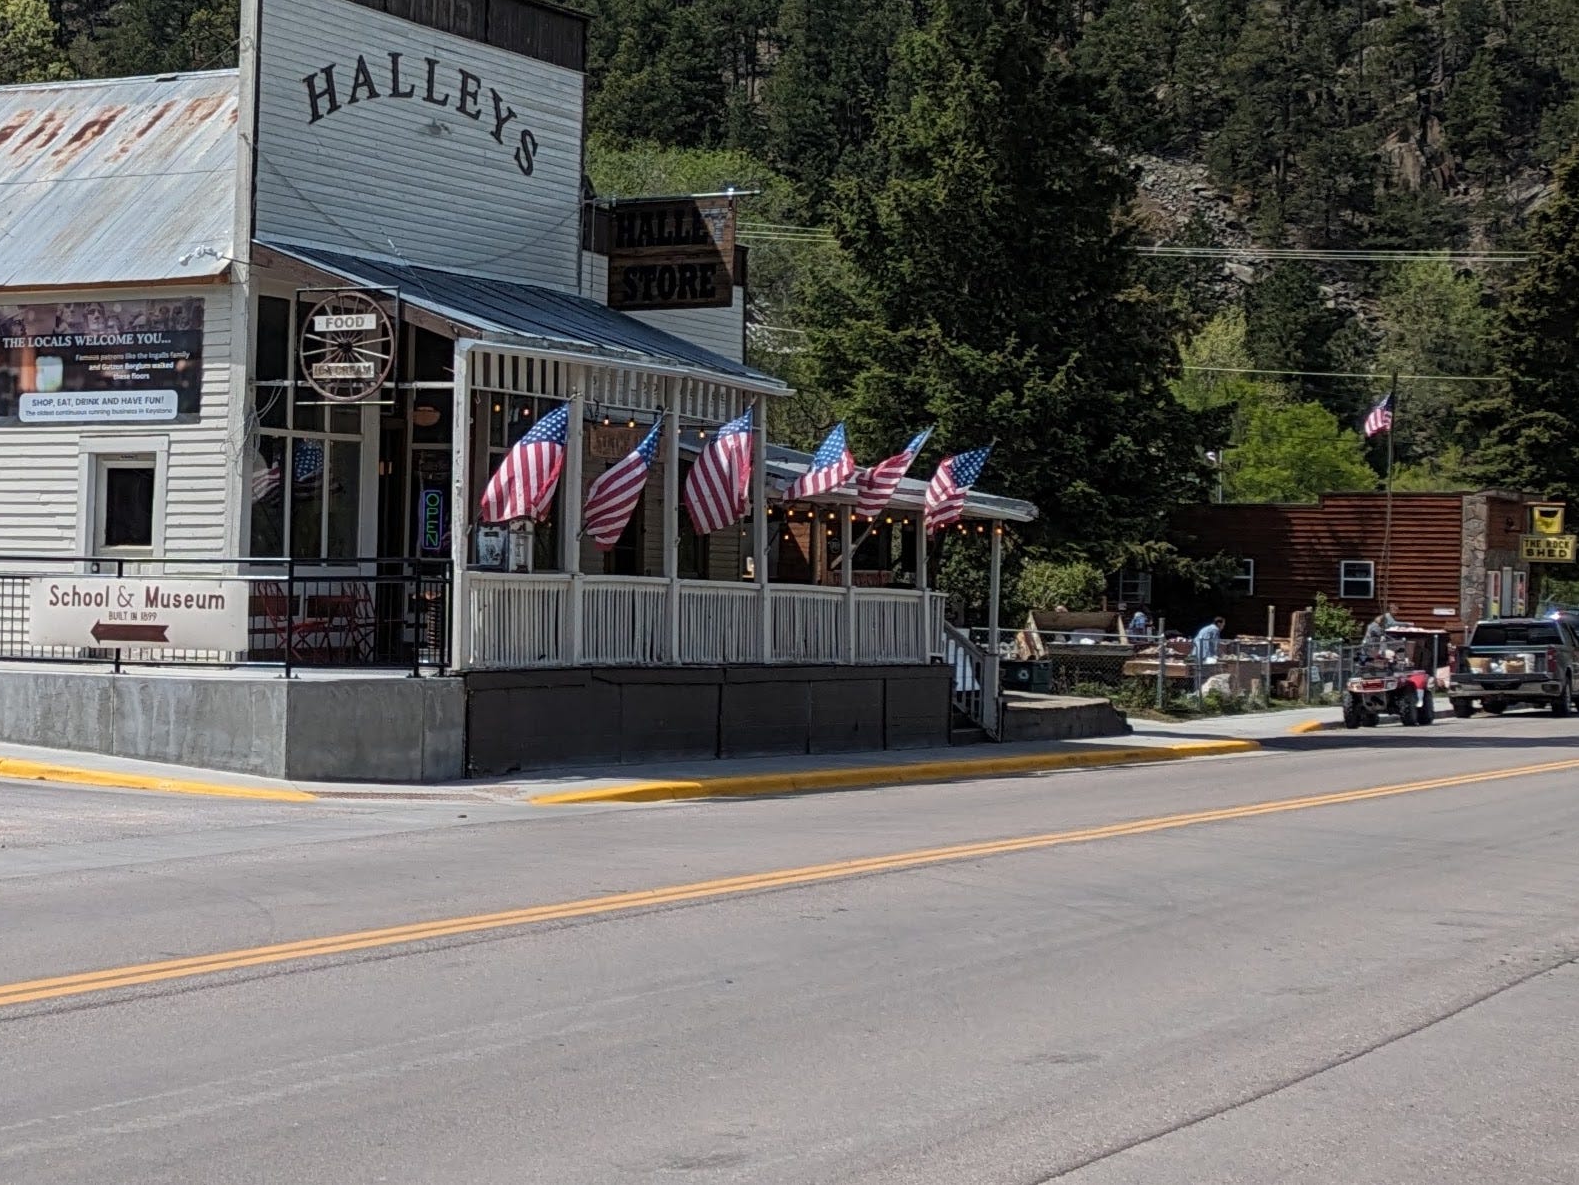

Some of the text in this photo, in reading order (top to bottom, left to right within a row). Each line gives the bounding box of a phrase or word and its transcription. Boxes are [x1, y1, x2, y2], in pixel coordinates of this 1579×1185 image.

[302, 52, 539, 176] HALLEYS
[623, 263, 717, 301] STORE
[325, 316, 365, 329] FOOD
[3, 333, 171, 348] THE LOCALS WELCOME YOU...
[131, 372, 150, 380] floors
[31, 396, 165, 407] SHOP, EAT, DRINK AND HAVE FUN!
[145, 407, 173, 415] Keystone
[426, 493, 440, 546] OPEN
[1524, 540, 1569, 549] THE ROCK
[1526, 549, 1567, 557] SHED
[49, 584, 225, 610] School & Museum
[108, 611, 128, 621] BUILT
[131, 611, 138, 621] IN
